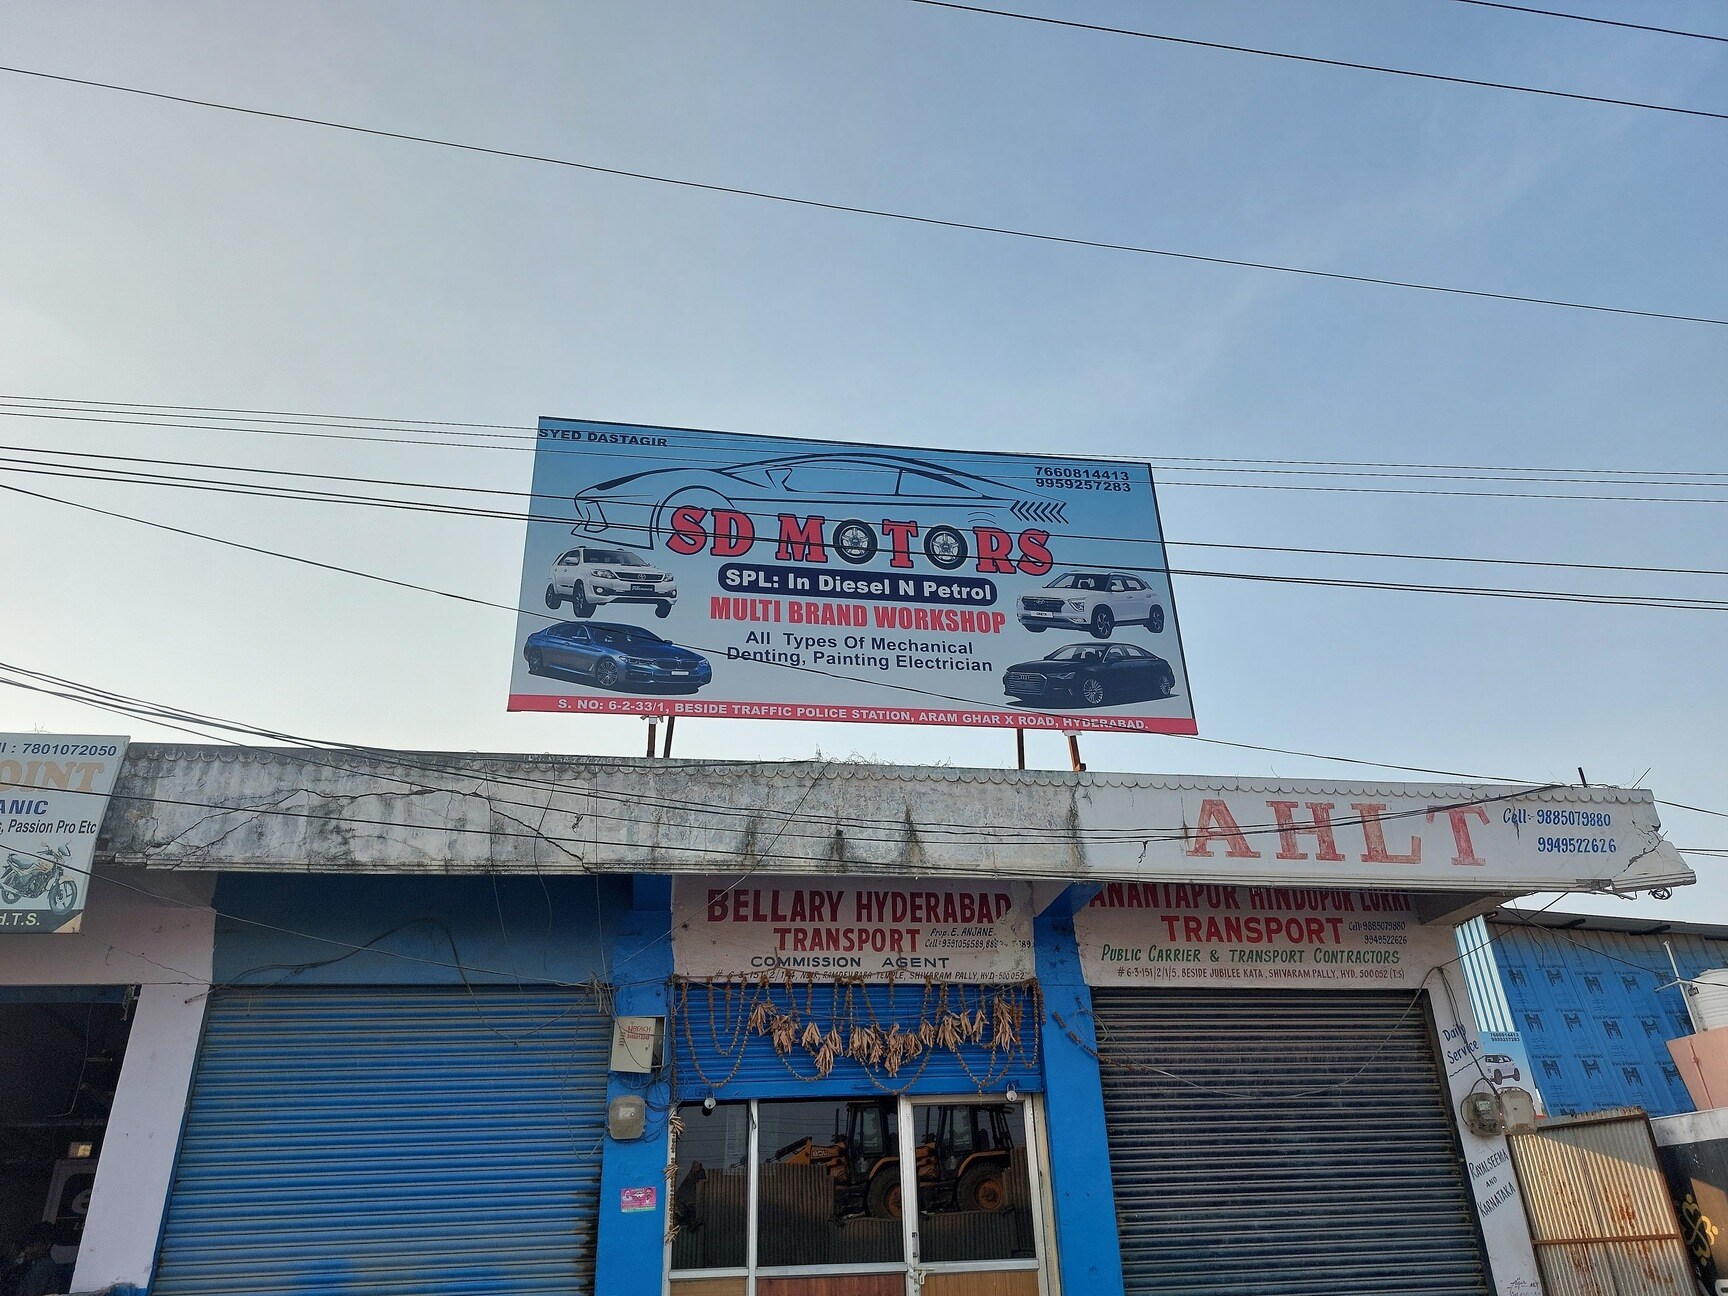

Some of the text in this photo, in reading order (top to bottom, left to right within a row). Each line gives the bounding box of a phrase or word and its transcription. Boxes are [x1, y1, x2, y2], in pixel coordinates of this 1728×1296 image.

[539, 428, 668, 447] SYED DASTAGIR
[1034, 466, 1129, 481] 7660814413
[1035, 477, 1131, 492] 9959257283
[666, 505, 1054, 576] SD MOTORS
[725, 568, 991, 600] SPL: In Diesel N Petrol
[710, 596, 1006, 634] MULTI BRAND WORKSHOP
[745, 630, 973, 655] All Types Of Mechanical
[727, 646, 993, 672] Denting, Painting Electrician
[558, 698, 572, 710] S.
[577, 699, 603, 711] NO:
[608, 700, 671, 714] 6-2-33/1,
[674, 702, 727, 715] BESIDE
[732, 704, 792, 717] TRAFFIC
[797, 706, 847, 719] POLICE
[851, 708, 915, 724] STATION,
[918, 711, 958, 723] ARAM
[962, 713, 1001, 725] GHAR
[1004, 714, 1014, 725] X
[1018, 715, 1060, 729] ROAD,
[22, 743, 117, 757] 7801072050
[7, 818, 54, 834] Passion
[56, 819, 76, 834] Pro
[78, 820, 97, 834] Etc
[1536, 809, 1611, 828] 9885079880
[1186, 798, 1490, 867] AHLT
[1537, 836, 1617, 853] 9949522626
[706, 888, 1013, 924] BELLARY HYDERABAD
[773, 927, 921, 953] TRANSPORT
[1160, 915, 1344, 944] TRANSPORT
[750, 956, 950, 969] COMMISSION AGENT
[1148, 944, 1201, 962] CARRIER
[1209, 949, 1220, 963] &
[1229, 949, 1305, 964] TRANSPORT
[1313, 947, 1401, 964] CONTRACTORS
[1181, 967, 1207, 978] BESIDE
[1209, 967, 1241, 978] JUBILEE
[1268, 968, 1310, 979] SHIVARAM
[1359, 969, 1388, 979] 500052
[1469, 1148, 1509, 1181] RAYALSEEMA
[1485, 1176, 1498, 1188] AND
[1477, 1181, 1516, 1217] KARNATAKA
